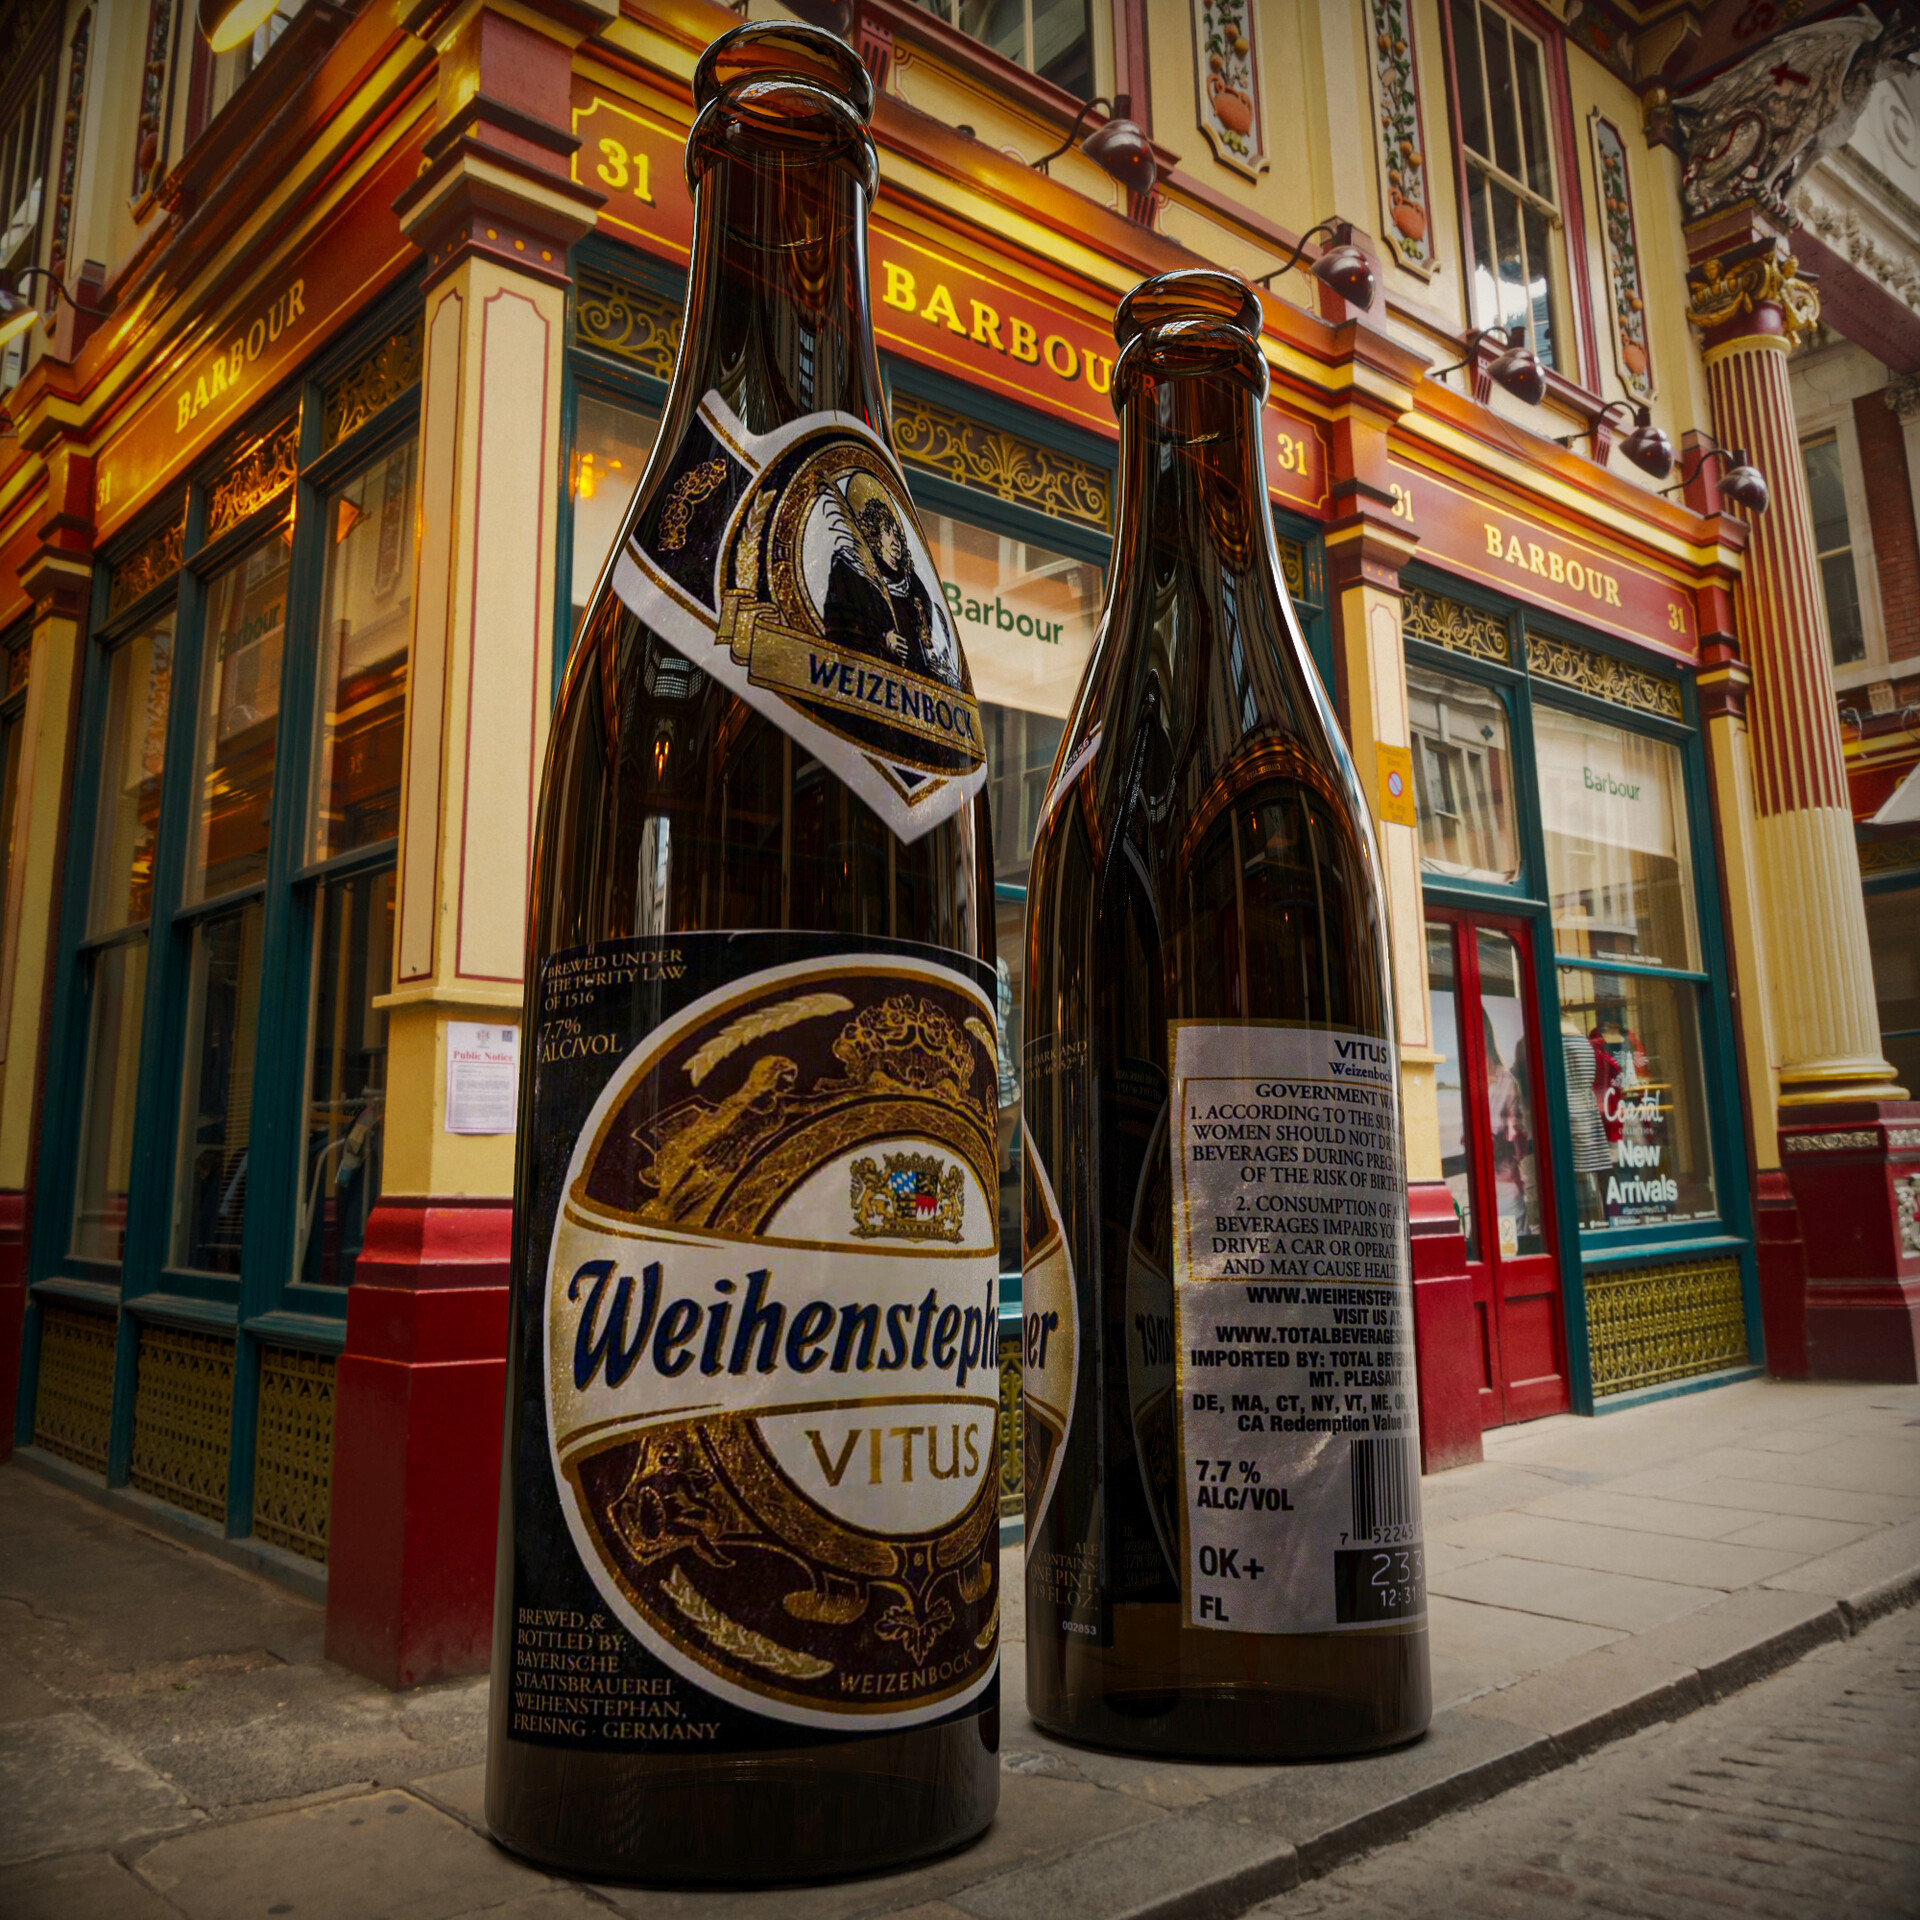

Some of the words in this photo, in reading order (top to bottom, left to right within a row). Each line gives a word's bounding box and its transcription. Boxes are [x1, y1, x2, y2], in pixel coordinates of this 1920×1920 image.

[596, 138, 653, 202] 31
[882, 259, 1113, 395] BARBOU
[175, 278, 306, 434] BARBOUR
[1277, 432, 1308, 476] 31
[96, 471, 112, 512] 31
[1390, 483, 1415, 523] 31
[1484, 523, 1622, 607] BARBOUR
[1667, 602, 1686, 634] 31
[942, 581, 1064, 645] Barbour
[809, 653, 976, 742] WEIZENBOCK
[1583, 766, 1640, 800] Barbour
[547, 956, 607, 980] BREWED
[612, 949, 684, 968] UNDER
[546, 977, 571, 995] THE
[575, 969, 638, 990] PURITY
[643, 964, 689, 981] LAW
[544, 995, 561, 1011] OF
[565, 989, 595, 1009] 1516
[543, 1016, 581, 1041] 7.7%
[453, 1050, 481, 1061] Public
[485, 1051, 513, 1062] Notice
[541, 1033, 623, 1063] ALC/VOL
[1059, 1040, 1088, 1056] AND
[1334, 1040, 1387, 1064] VITUS
[1256, 1083, 1378, 1107] GOVERNMENT
[1604, 1087, 1664, 1122] Coastal
[1190, 1106, 1202, 1120] 1.
[1206, 1105, 1320, 1122] ACCORDING
[1323, 1107, 1346, 1124] TO
[1348, 1110, 1374, 1128] THE
[1192, 1124, 1271, 1140] WOMEN
[1276, 1125, 1346, 1144] SHOULD
[1349, 1130, 1377, 1148] NOT
[1192, 1145, 1299, 1163] BEVERAGES
[1303, 1148, 1364, 1167] DURING
[1617, 1140, 1661, 1168] New
[1241, 1167, 1266, 1182] OF
[1270, 1167, 1309, 1184] THE
[1314, 1170, 1348, 1187] RISK
[1350, 1171, 1368, 1188] OF
[1370, 1174, 1398, 1193] BIRTH
[1606, 1174, 1678, 1205] Arrivals
[1236, 1196, 1251, 1211] 2.
[1256, 1195, 1377, 1217] CONSUMPTION
[1379, 1202, 1392, 1219] OF
[1216, 1217, 1318, 1234] BEVERAGES
[1323, 1220, 1378, 1238] IMPAIRS
[1212, 1238, 1269, 1253] DRIVE
[1274, 1239, 1287, 1254] A
[1291, 1239, 1326, 1255] CAR
[1330, 1241, 1351, 1256] OR
[1222, 1259, 1265, 1275] AND
[1270, 1260, 1309, 1276] MAY
[1313, 1261, 1360, 1277] CAUSE
[568, 1260, 998, 1392] Weihensteph
[1333, 1308, 1369, 1325] VISIT
[1373, 1308, 1388, 1326] US
[1191, 1350, 1290, 1367] IMPORTED
[1296, 1351, 1325, 1368] BY:
[1330, 1351, 1373, 1367] TOTAL
[1309, 1371, 1339, 1388] MT.
[1193, 1394, 1225, 1413] DE,
[1232, 1395, 1269, 1414] MA,
[1276, 1395, 1305, 1414] CT,
[1311, 1395, 1340, 1414] NY,
[1345, 1395, 1367, 1414] VT,
[1371, 1394, 1392, 1413] ME,
[1238, 1414, 1264, 1432] CA
[1270, 1414, 1370, 1435] Redemption
[1373, 1414, 1402, 1431] Value
[805, 1423, 979, 1487] VITUS
[1196, 1460, 1231, 1483] 7.7
[1239, 1461, 1262, 1484] %
[1197, 1486, 1294, 1511] ALC/VOL
[1340, 1532, 1349, 1546] 7
[1373, 1525, 1414, 1544] 52245
[1074, 1541, 1099, 1556] ALE
[1038, 1551, 1098, 1572] CONTAINS:
[1030, 1563, 1053, 1583] ONE
[1056, 1569, 1099, 1592] PINT,
[518, 1607, 585, 1629] BREWED
[590, 1613, 606, 1630] &
[1199, 1594, 1230, 1622] FL
[1062, 1620, 1096, 1636] 002853
[518, 1629, 593, 1650] BOTTLED
[599, 1634, 627, 1652] BY:
[516, 1649, 620, 1673] BAYERISCHE
[839, 1649, 973, 1695] WEIZENBOCK
[514, 1691, 687, 1719] WEIHENSTEPHAN,
[514, 1713, 587, 1737] FREISING
[602, 1721, 721, 1740] GERMANY
